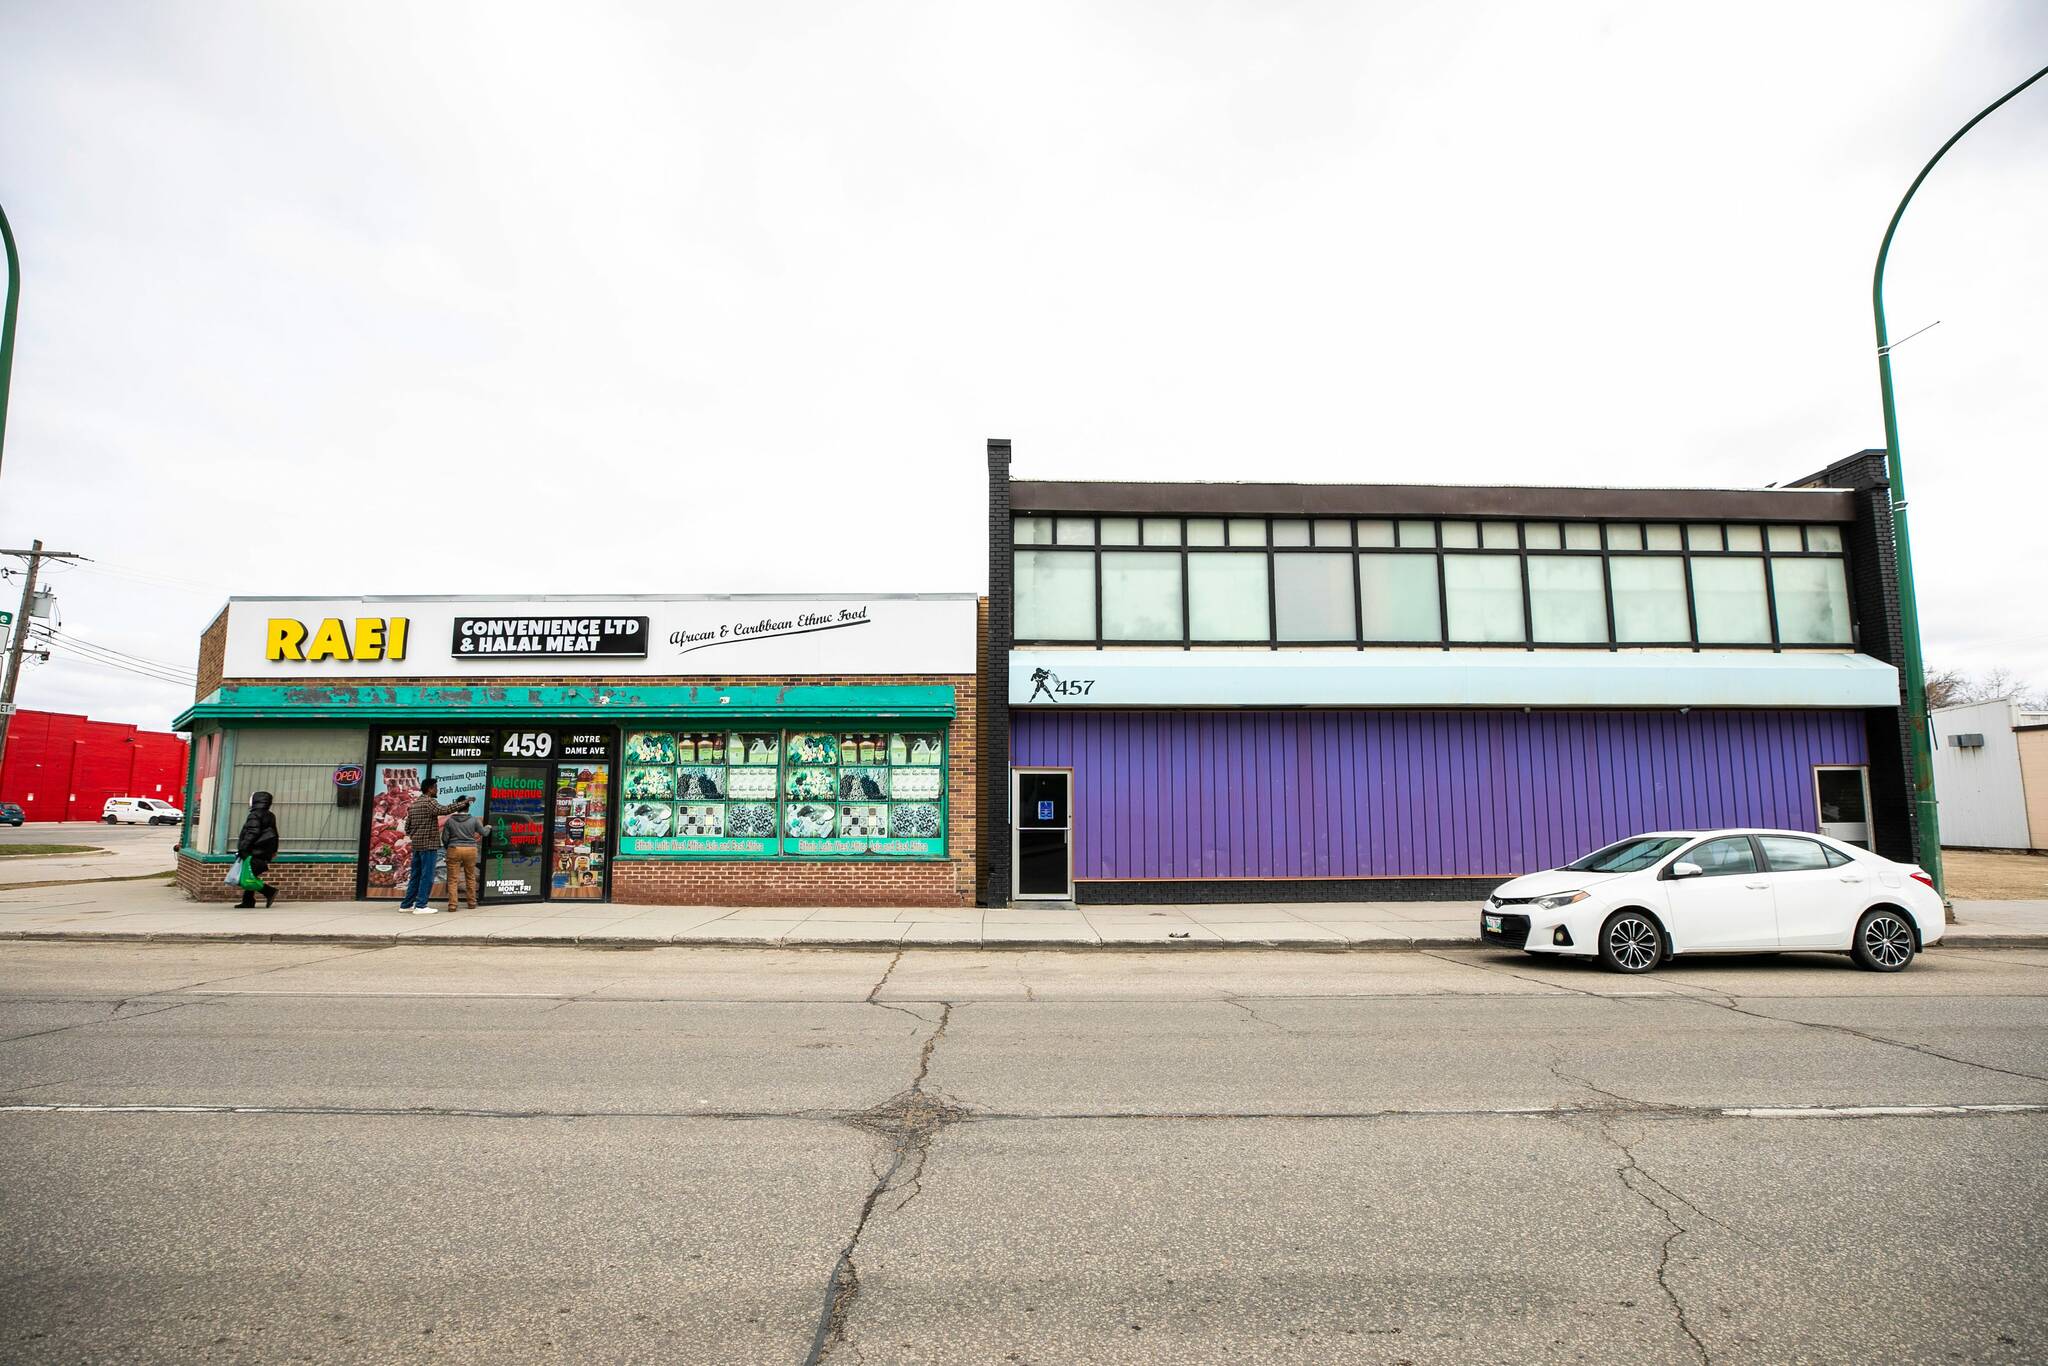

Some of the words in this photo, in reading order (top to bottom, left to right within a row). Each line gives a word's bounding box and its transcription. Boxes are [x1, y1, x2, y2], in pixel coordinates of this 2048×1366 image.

[460, 619, 600, 636] CONVENIENCE
[604, 619, 640, 635] LTD
[669, 630, 716, 647] African
[719, 625, 730, 638] &
[733, 619, 793, 636] Caribbean
[797, 612, 833, 627] Ethnic
[837, 606, 867, 622] Food
[265, 616, 410, 662] RAEI
[459, 637, 475, 652] &
[478, 636, 542, 652] HALAL
[546, 636, 601, 652] MEAT
[1054, 679, 1096, 695] 457
[380, 735, 428, 752] RAEI
[438, 735, 491, 744] CONVENIENCE
[503, 732, 552, 758] 459
[573, 735, 601, 744] NOTRE
[450, 748, 482, 757] LIMITED
[565, 746, 588, 755] DAME
[589, 746, 606, 755] AVE
[334, 769, 361, 782] OPEN
[434, 773, 465, 782] Premium
[492, 775, 544, 789] Welcome
[439, 785, 454, 795] Fish
[491, 788, 543, 799] Bienvenue
